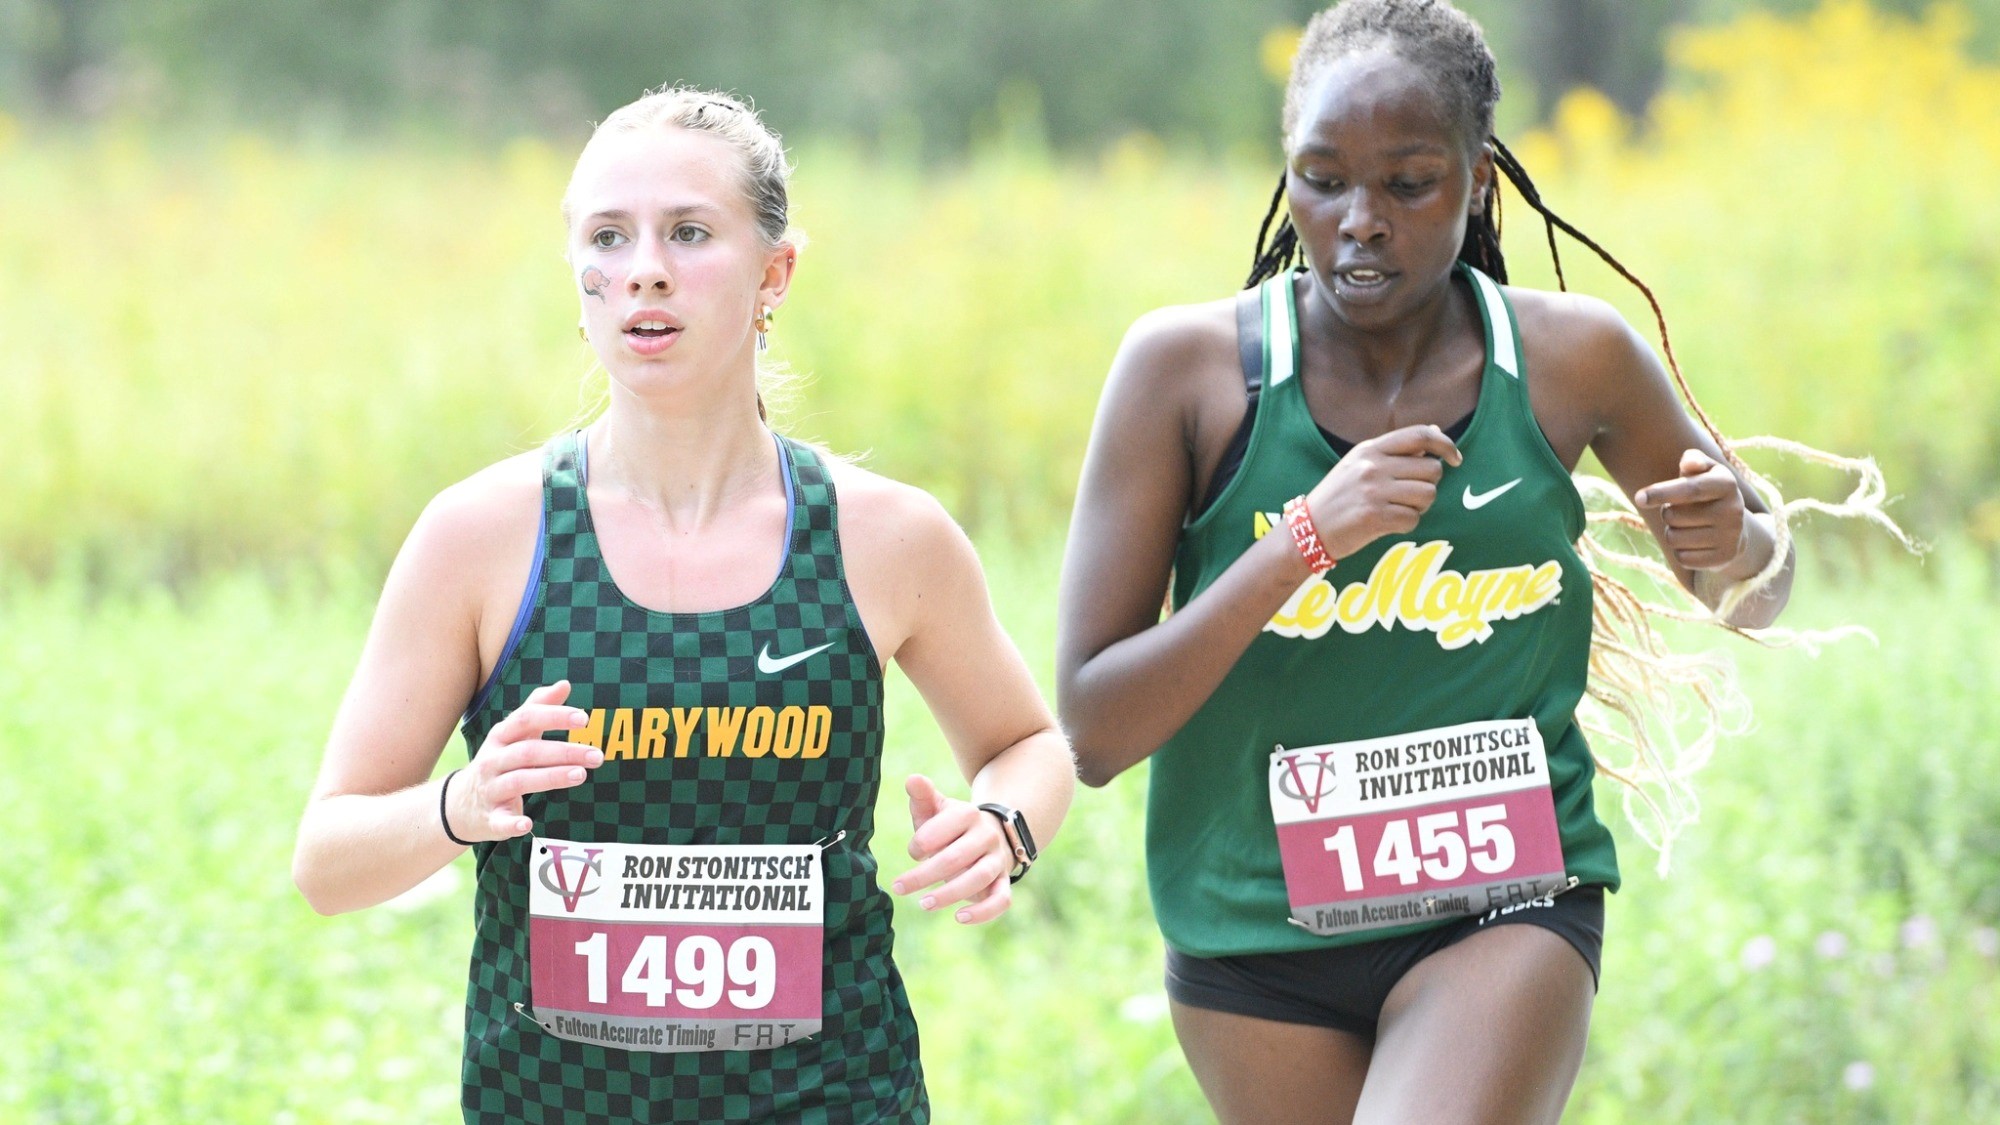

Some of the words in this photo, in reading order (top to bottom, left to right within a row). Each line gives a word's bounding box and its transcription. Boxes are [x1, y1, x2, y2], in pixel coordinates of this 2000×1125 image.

[567, 705, 833, 761] MARYWOOD
[1355, 747, 1400, 773] RON
[1405, 727, 1531, 765] STONITSCH
[1359, 751, 1536, 801] INVITATIONAL
[621, 855, 673, 879] RON
[676, 855, 811, 880] STONITSCH
[1323, 803, 1516, 892] 1455
[620, 884, 812, 911] INVITATIONAL
[1315, 907, 1359, 929] Fulton
[1361, 900, 1422, 923] Accurate
[1423, 893, 1471, 916] Timing
[1485, 879, 1542, 907] FAT
[574, 932, 777, 1010] 1499
[556, 1016, 599, 1039] Fulton
[600, 1020, 663, 1045] Accurate
[665, 1024, 716, 1048] Timing
[734, 1023, 796, 1046] FAT
